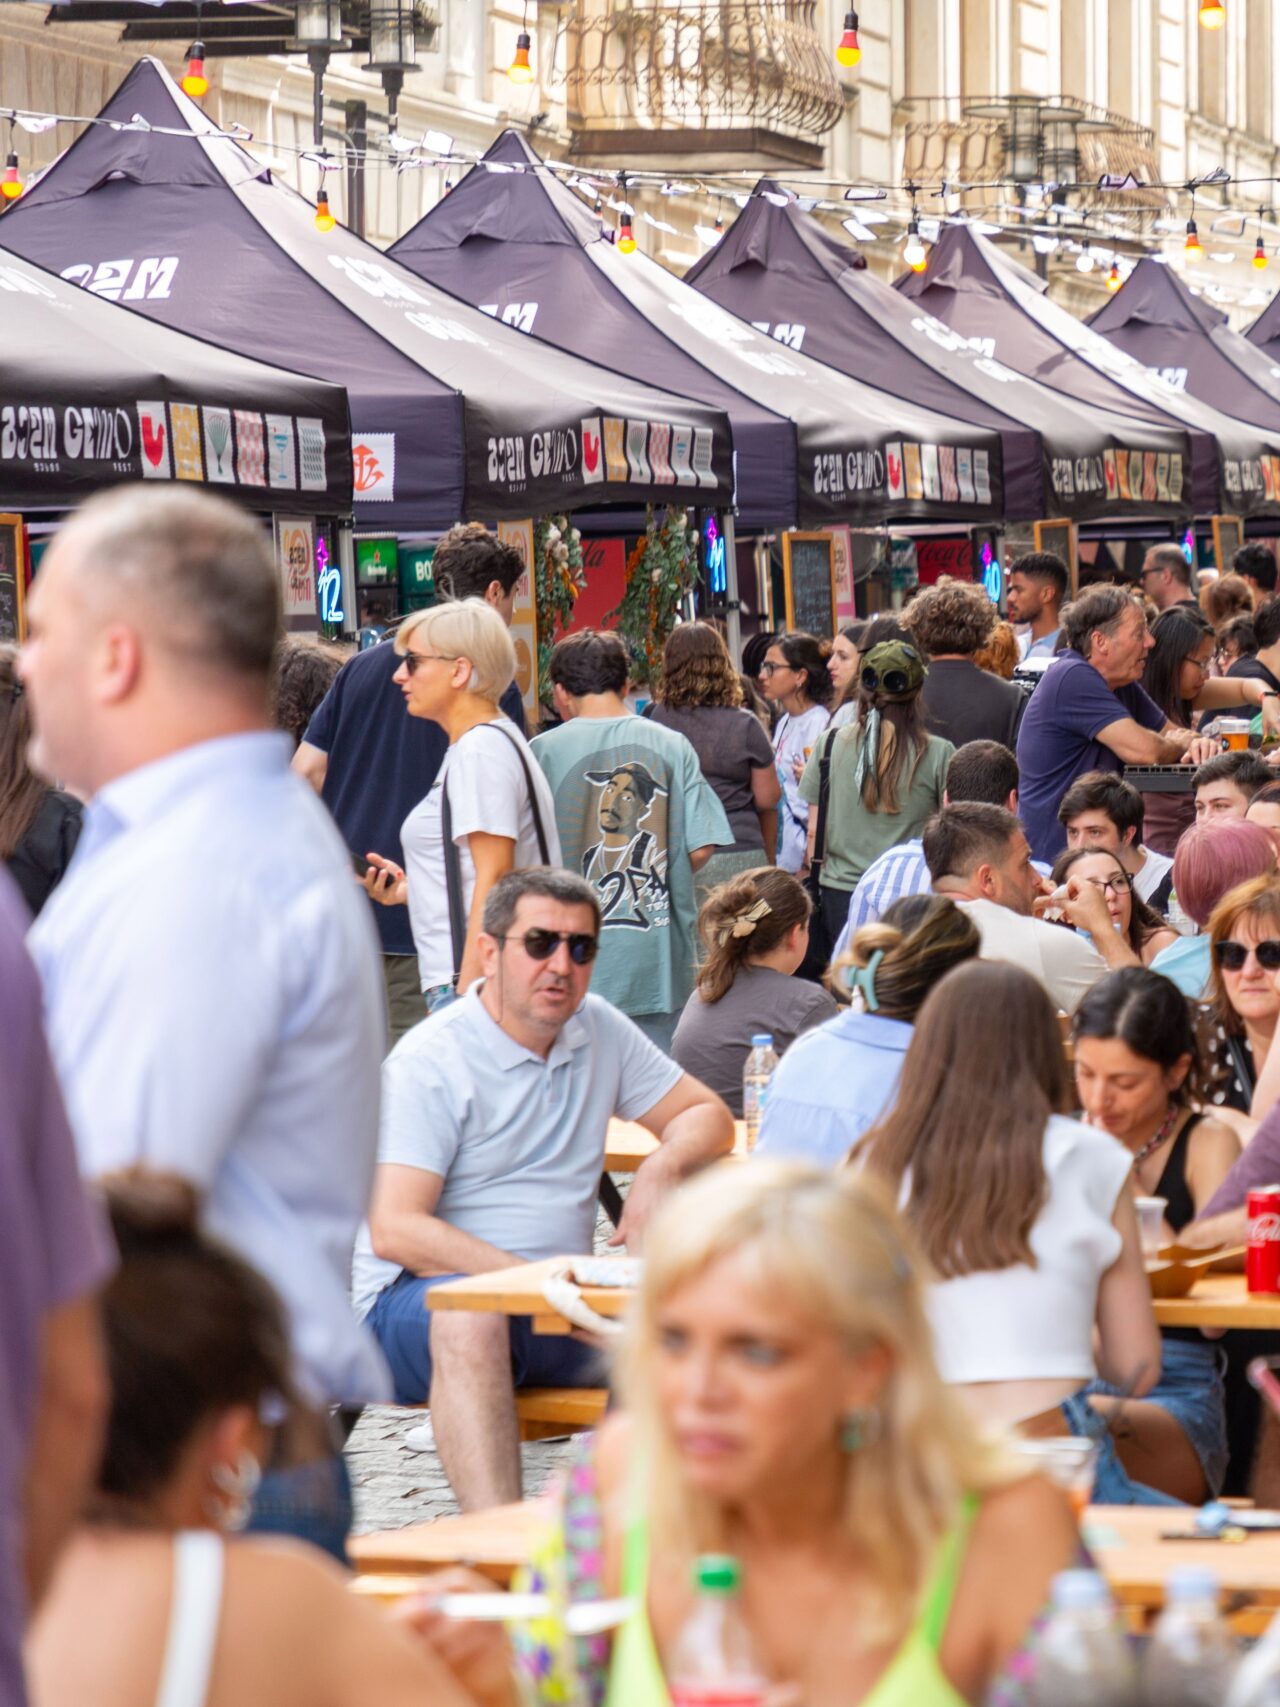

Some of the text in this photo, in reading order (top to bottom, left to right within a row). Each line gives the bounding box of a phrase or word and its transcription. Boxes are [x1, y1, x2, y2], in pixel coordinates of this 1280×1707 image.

[64, 406, 133, 460] GEMO
[529, 427, 578, 478] GEMO
[415, 560, 434, 582] BO
